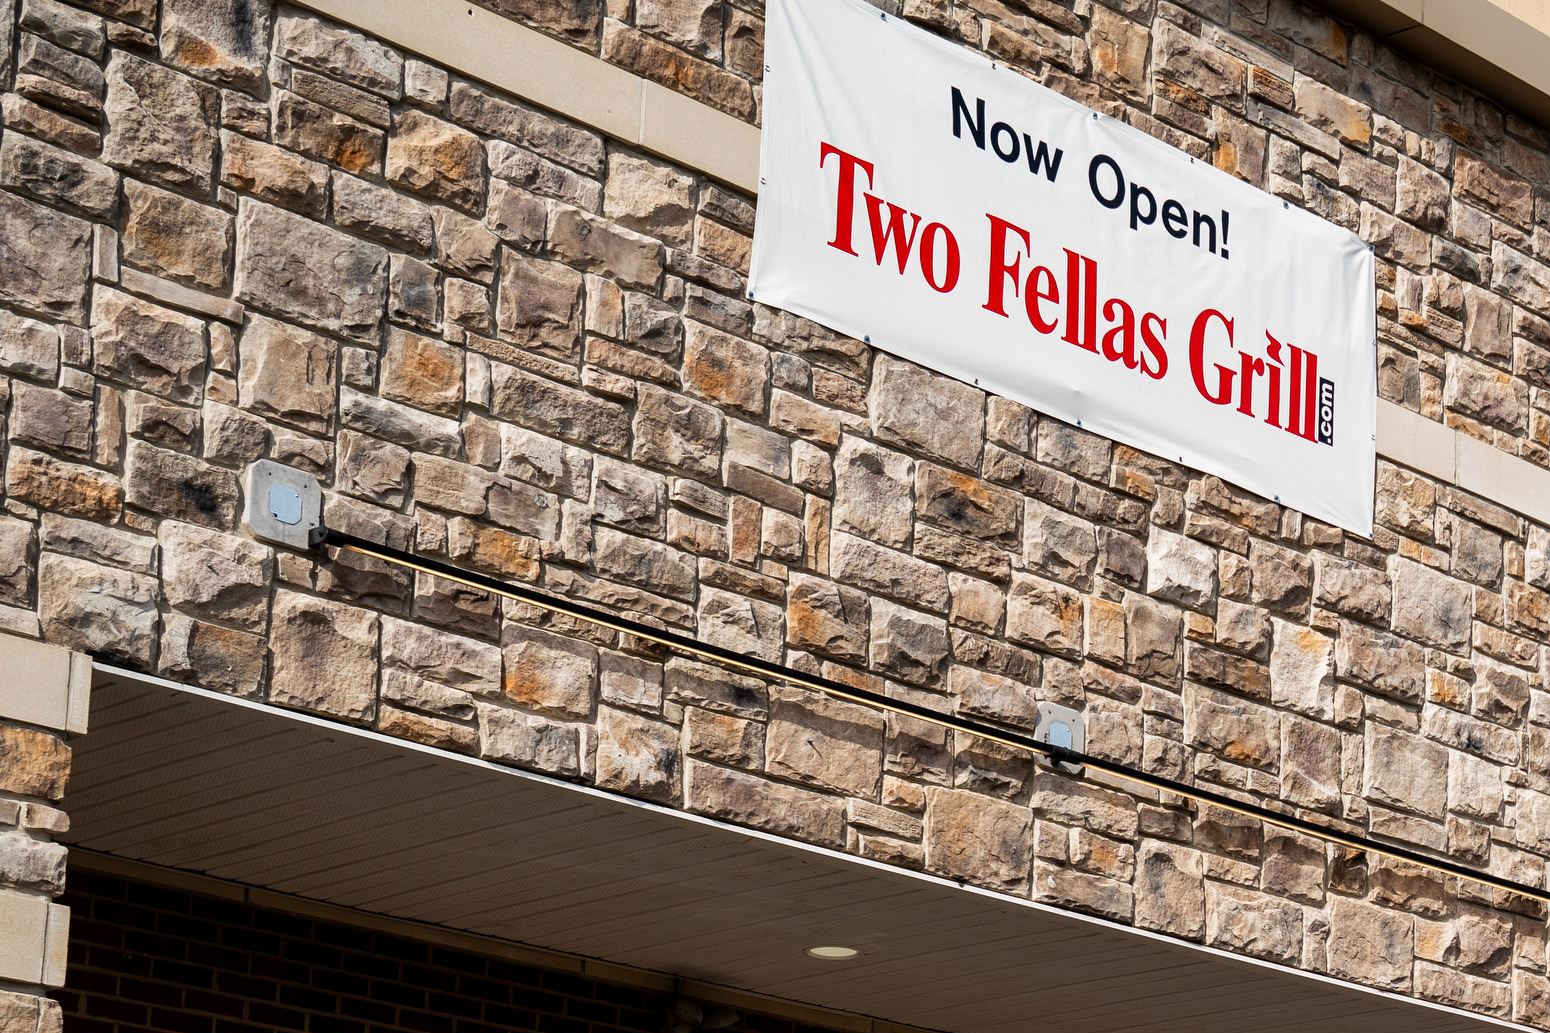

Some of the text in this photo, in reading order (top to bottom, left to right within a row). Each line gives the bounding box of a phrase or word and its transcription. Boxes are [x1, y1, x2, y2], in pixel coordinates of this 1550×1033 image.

[950, 86, 1230, 260] Now Open!
[819, 142, 1319, 444] Two Fellas Grill
[1320, 382, 1334, 444] .com
